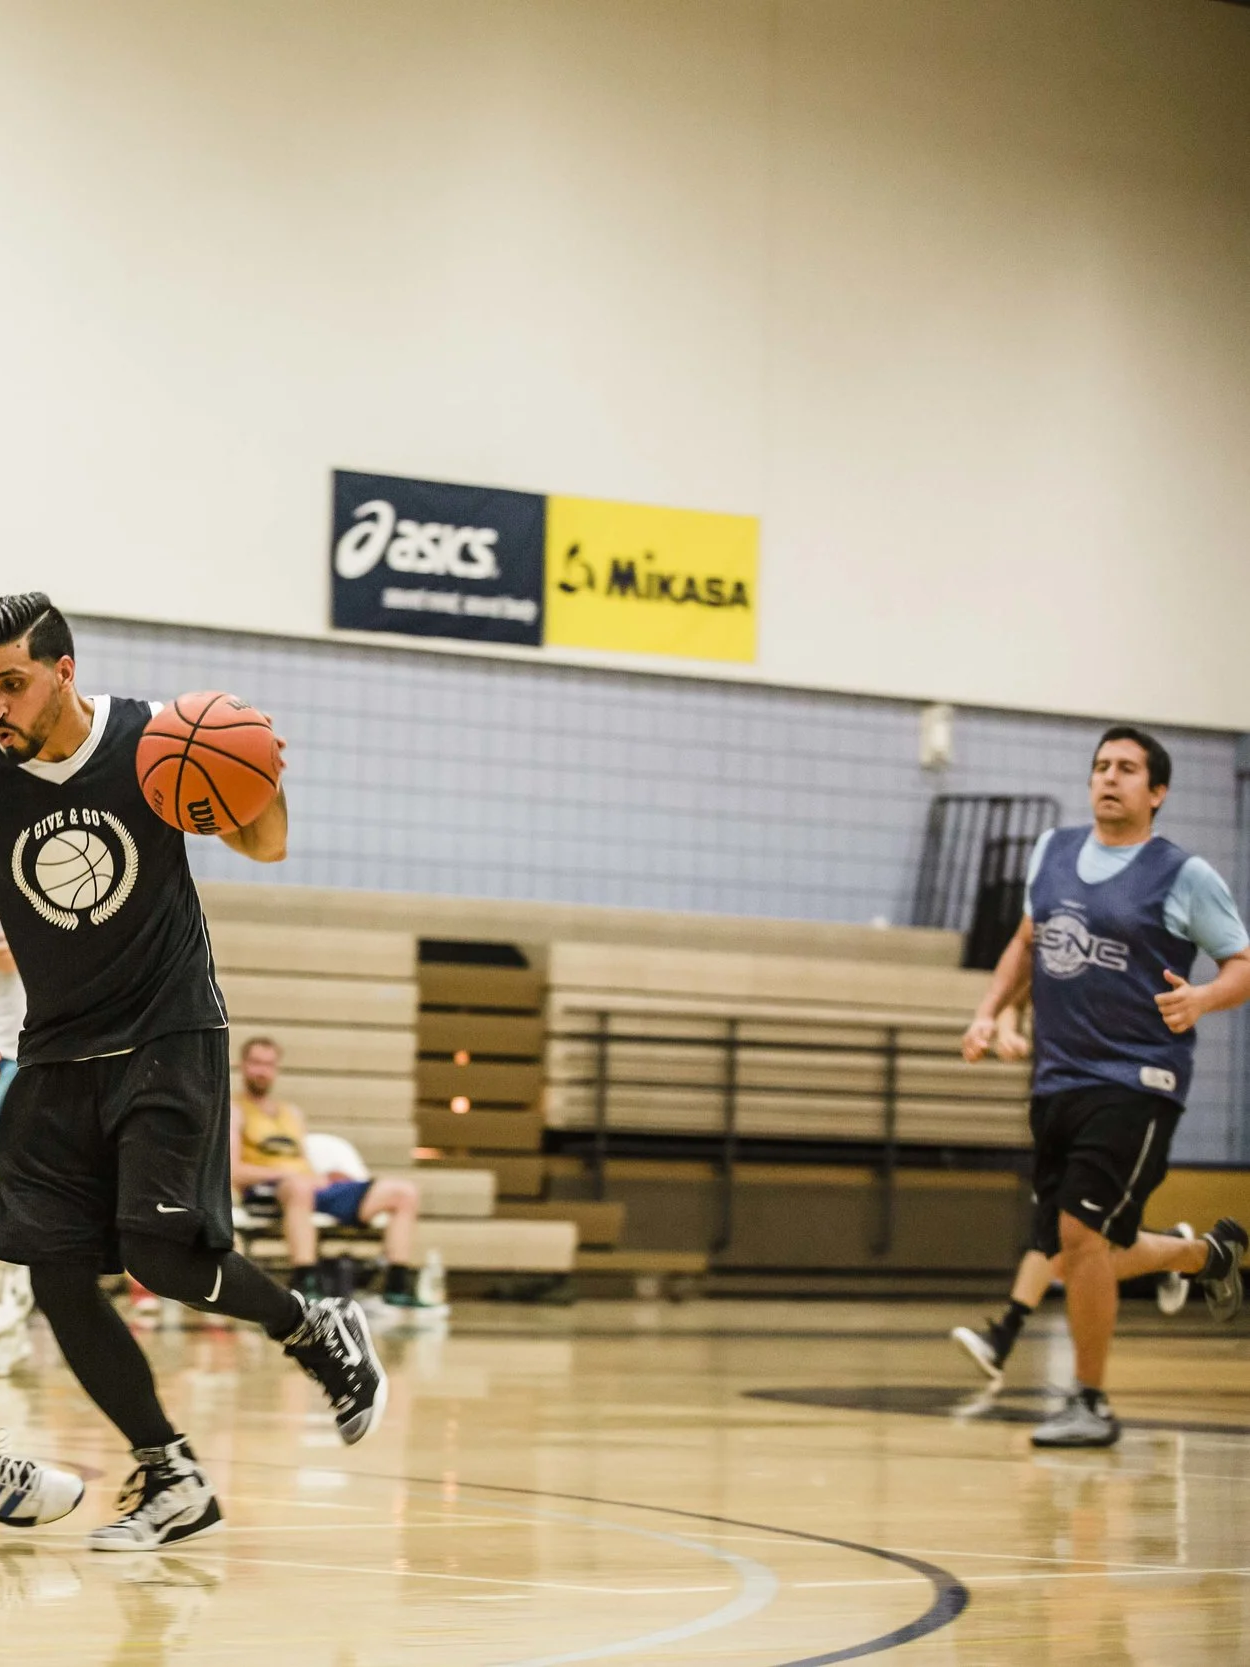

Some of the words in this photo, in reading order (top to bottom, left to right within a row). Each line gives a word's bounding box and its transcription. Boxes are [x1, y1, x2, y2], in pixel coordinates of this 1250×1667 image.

[386, 519, 501, 580] asics
[34, 810, 64, 840] GIVE
[70, 808, 79, 825] &
[82, 808, 100, 827] GO
